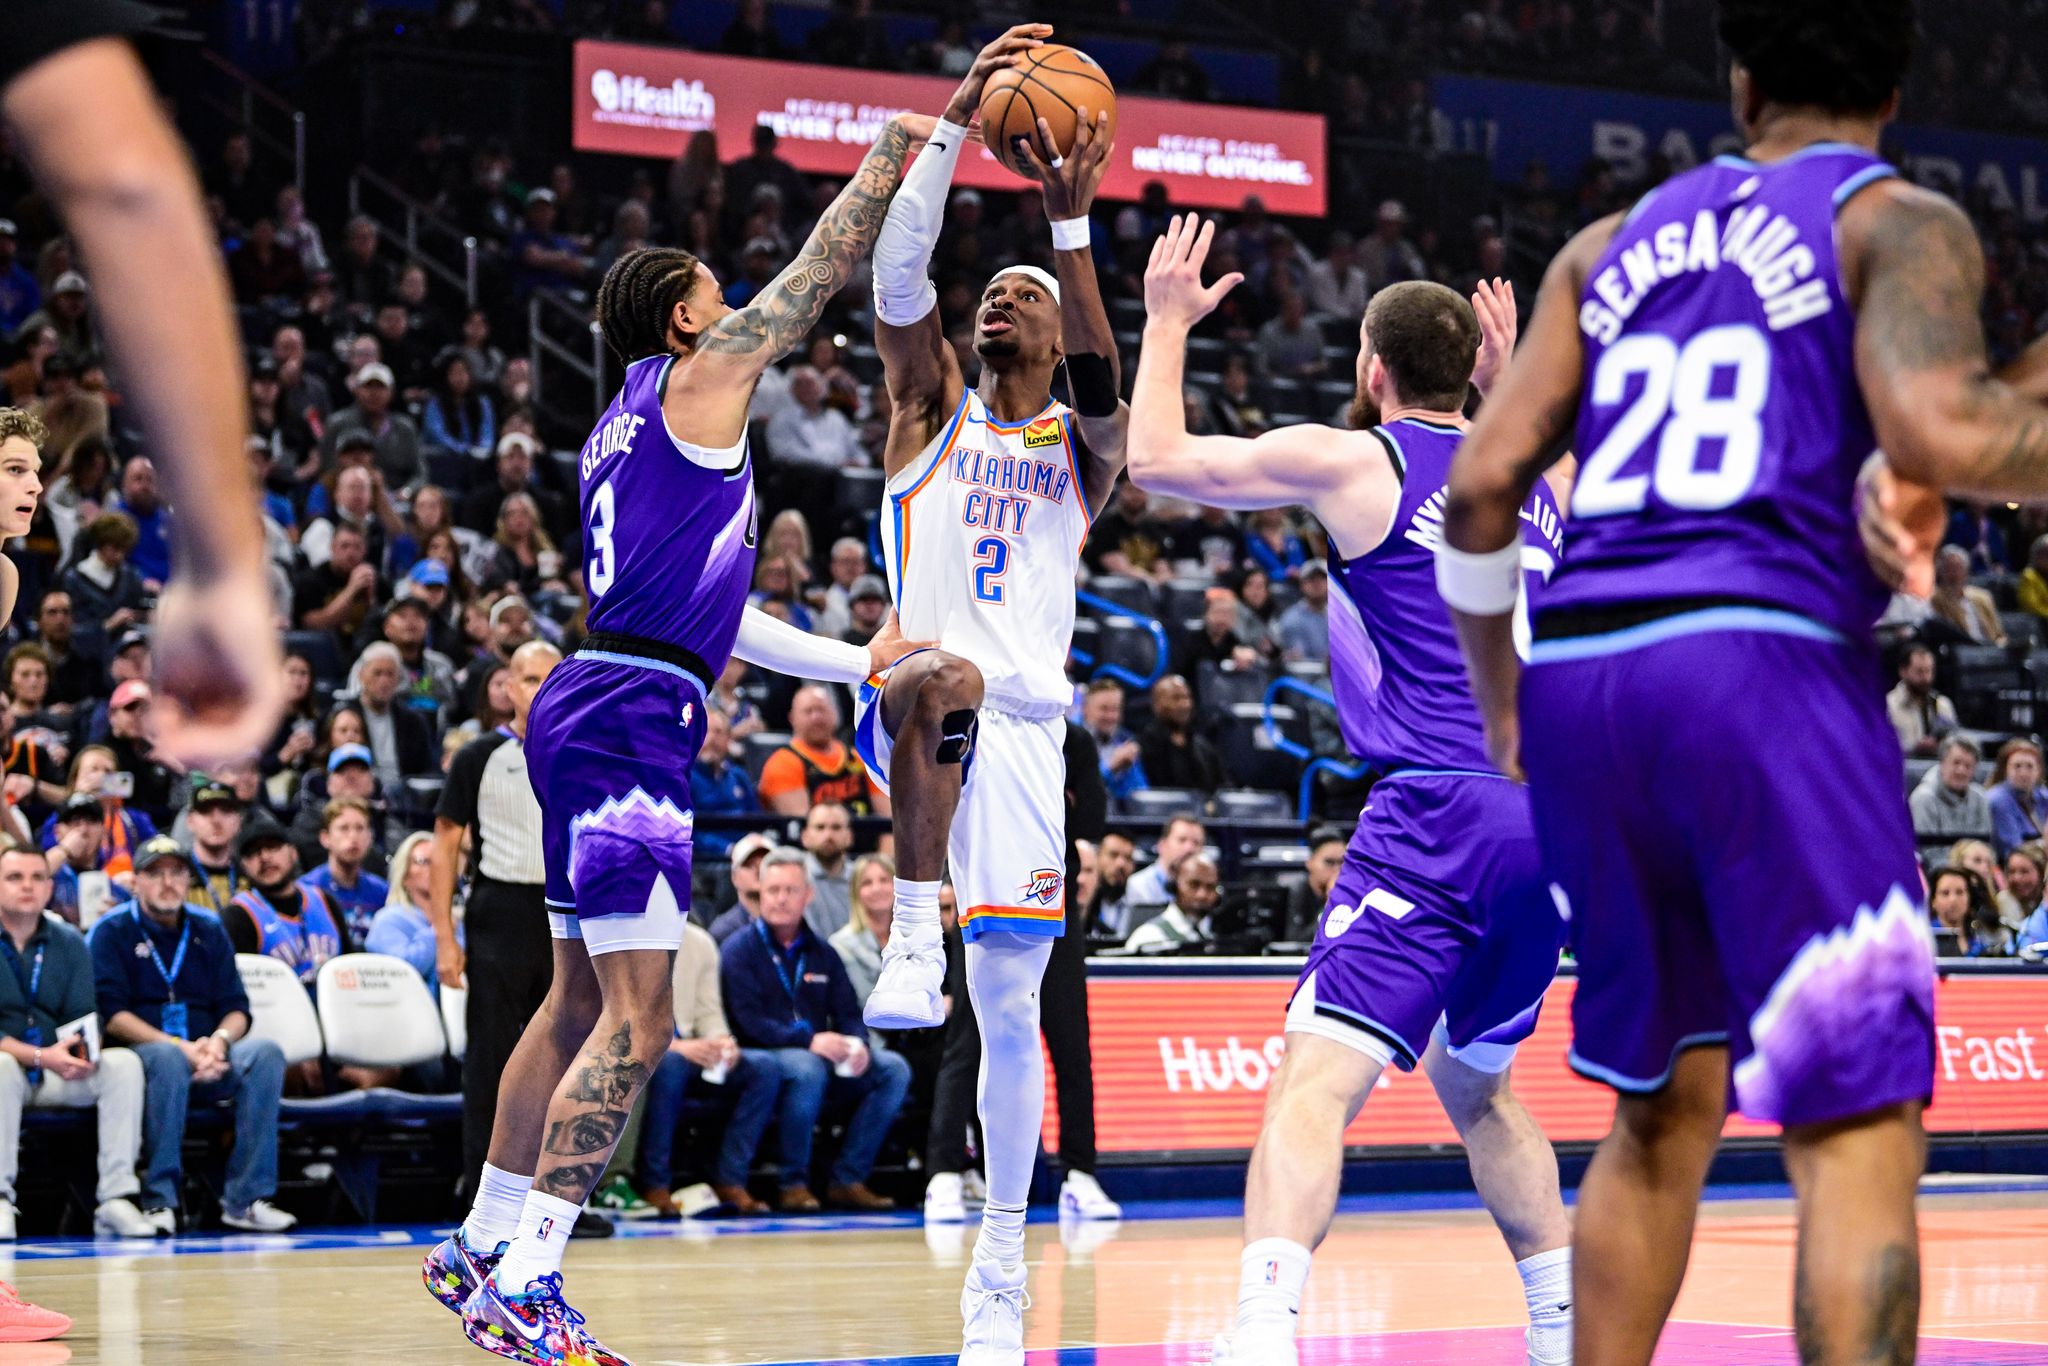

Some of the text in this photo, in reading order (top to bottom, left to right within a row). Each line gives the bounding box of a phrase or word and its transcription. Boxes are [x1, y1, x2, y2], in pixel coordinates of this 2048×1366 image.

[582, 413, 646, 481] GEORGE
[1571, 324, 1772, 517] 28
[949, 446, 1072, 505] KLAHOMA
[588, 479, 615, 598] 3
[963, 491, 1031, 535] CITY
[973, 535, 1010, 606] 2
[1936, 1025, 2044, 1081] Fast
